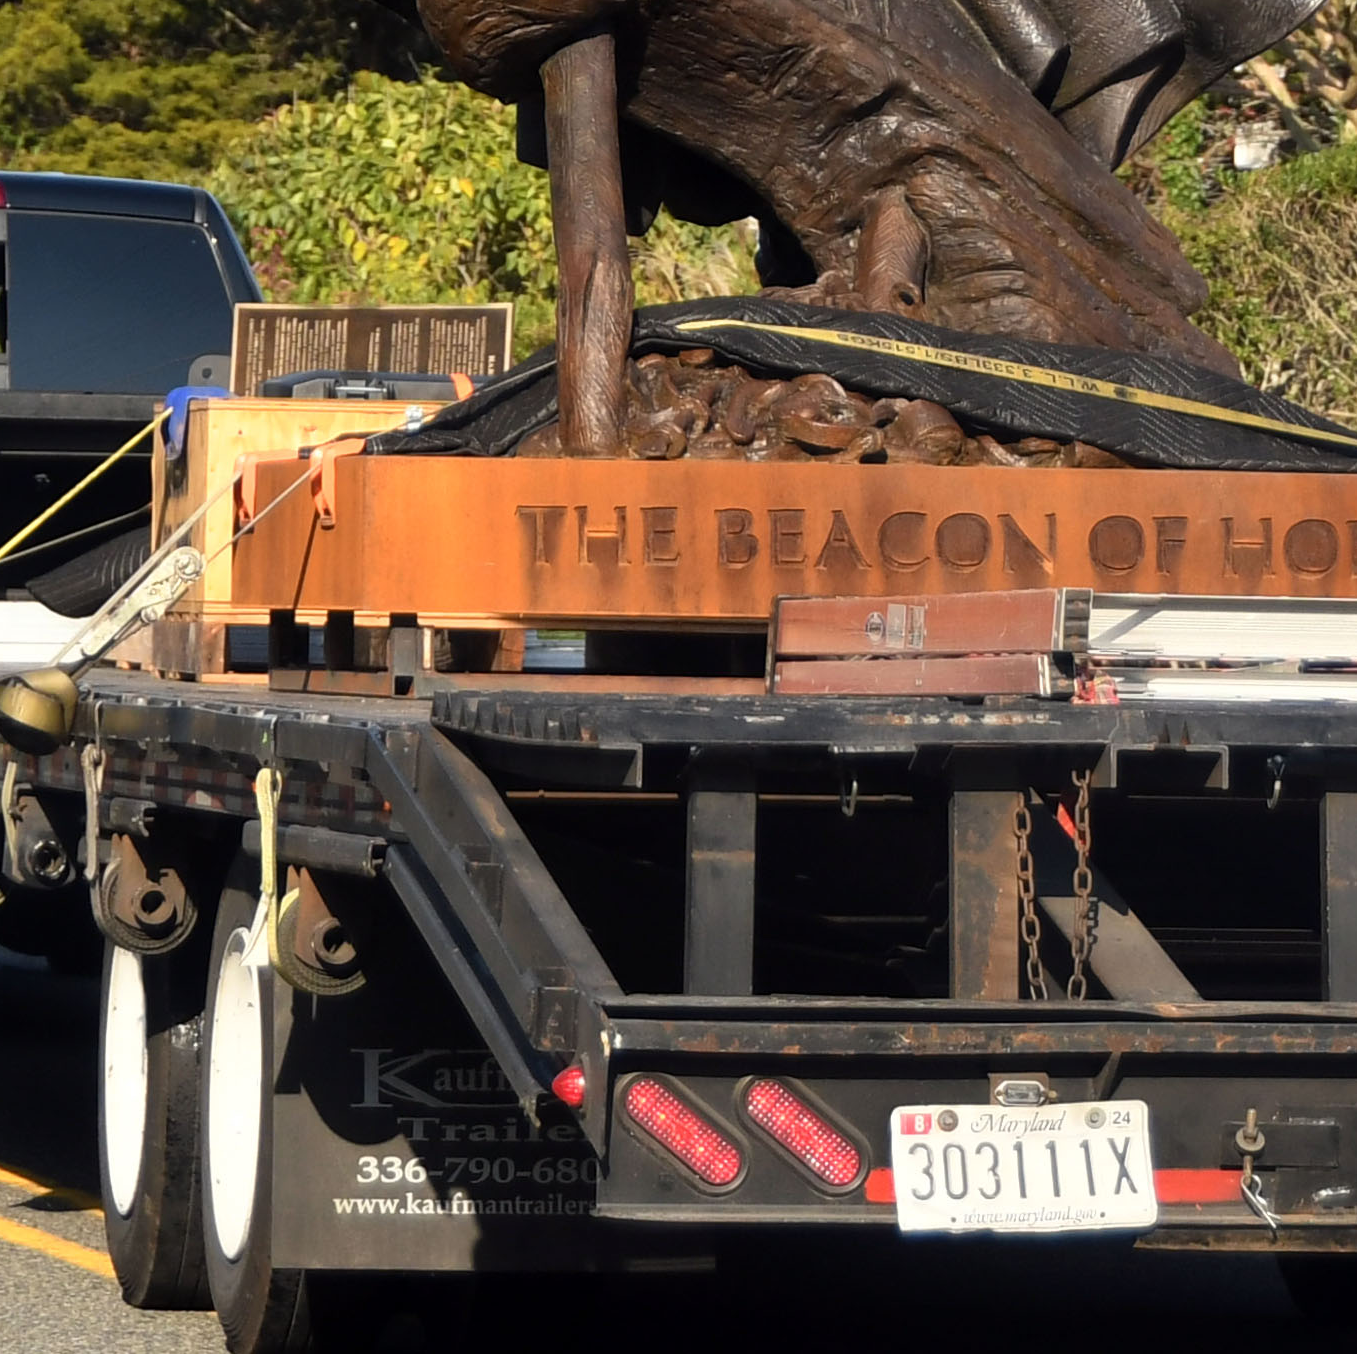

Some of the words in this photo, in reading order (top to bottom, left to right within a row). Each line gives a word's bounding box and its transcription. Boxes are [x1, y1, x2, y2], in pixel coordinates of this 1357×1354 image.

[514, 504, 682, 568] THE
[713, 508, 1059, 576] BEACON
[1087, 514, 1189, 577] OF
[913, 1113, 926, 1133] 8
[970, 1110, 1067, 1138] Maryland
[1111, 1110, 1132, 1126] 24
[355, 1155, 597, 1184] 336-790-680
[906, 1136, 1139, 1201] 303111X
